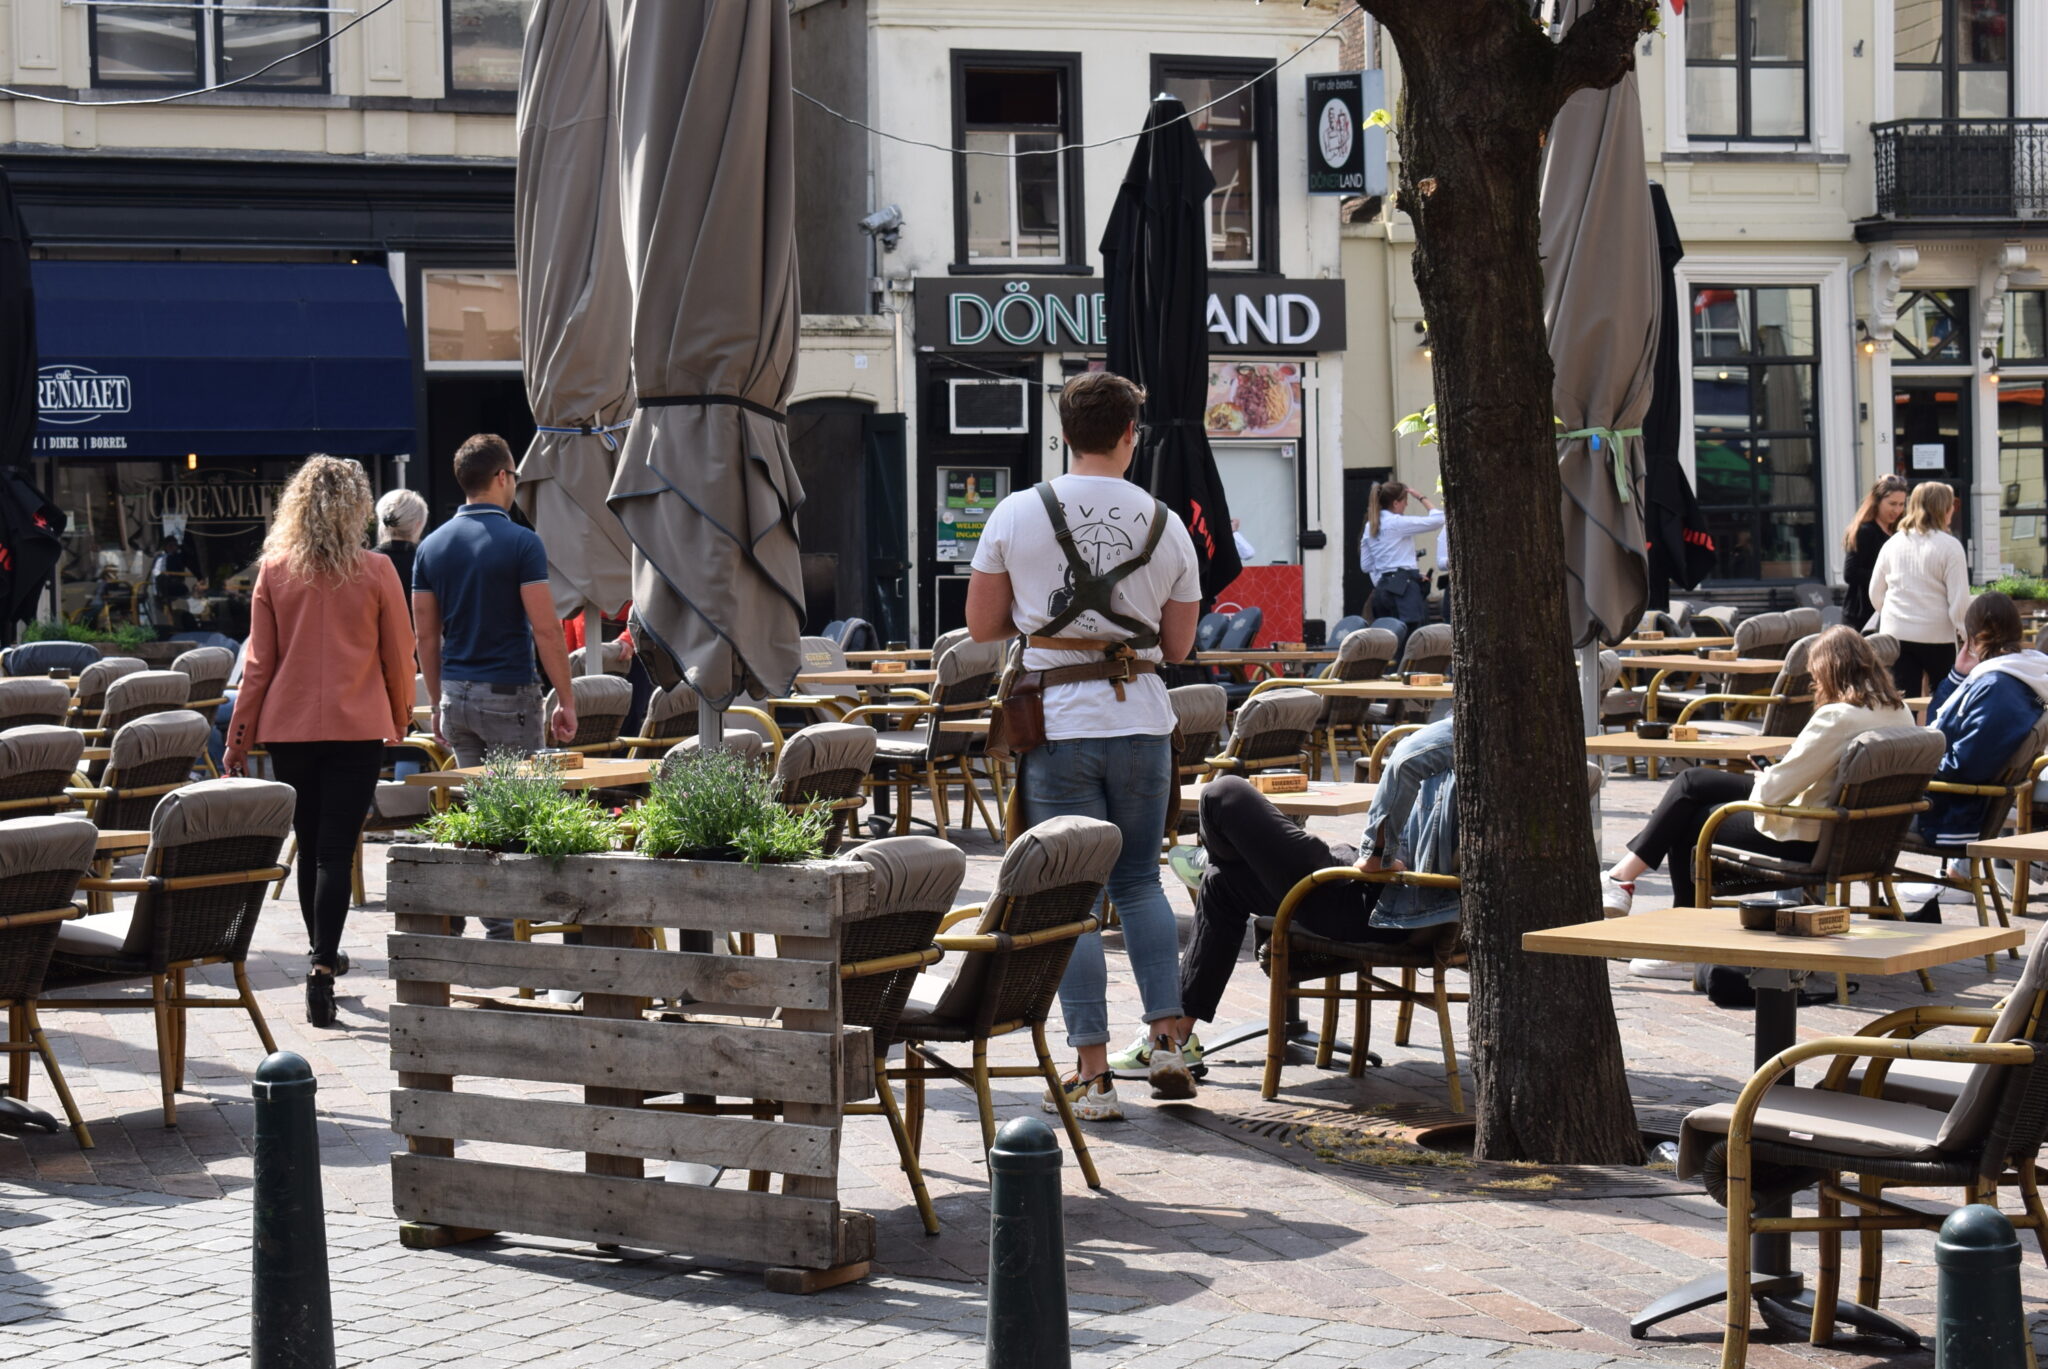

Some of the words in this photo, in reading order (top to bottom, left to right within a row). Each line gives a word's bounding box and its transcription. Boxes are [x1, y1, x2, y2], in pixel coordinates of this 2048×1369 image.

[949, 282, 1107, 345] DÖNE
[1206, 293, 1321, 345] AND
[38, 379, 127, 410] RENMAET
[49, 437, 79, 449] DINER
[90, 437, 128, 449] BORREL
[1049, 435, 1059, 451] 3
[955, 531, 982, 539] INGAN
[1073, 619, 1099, 633] TIMES
[1079, 613, 1096, 625] RIM
